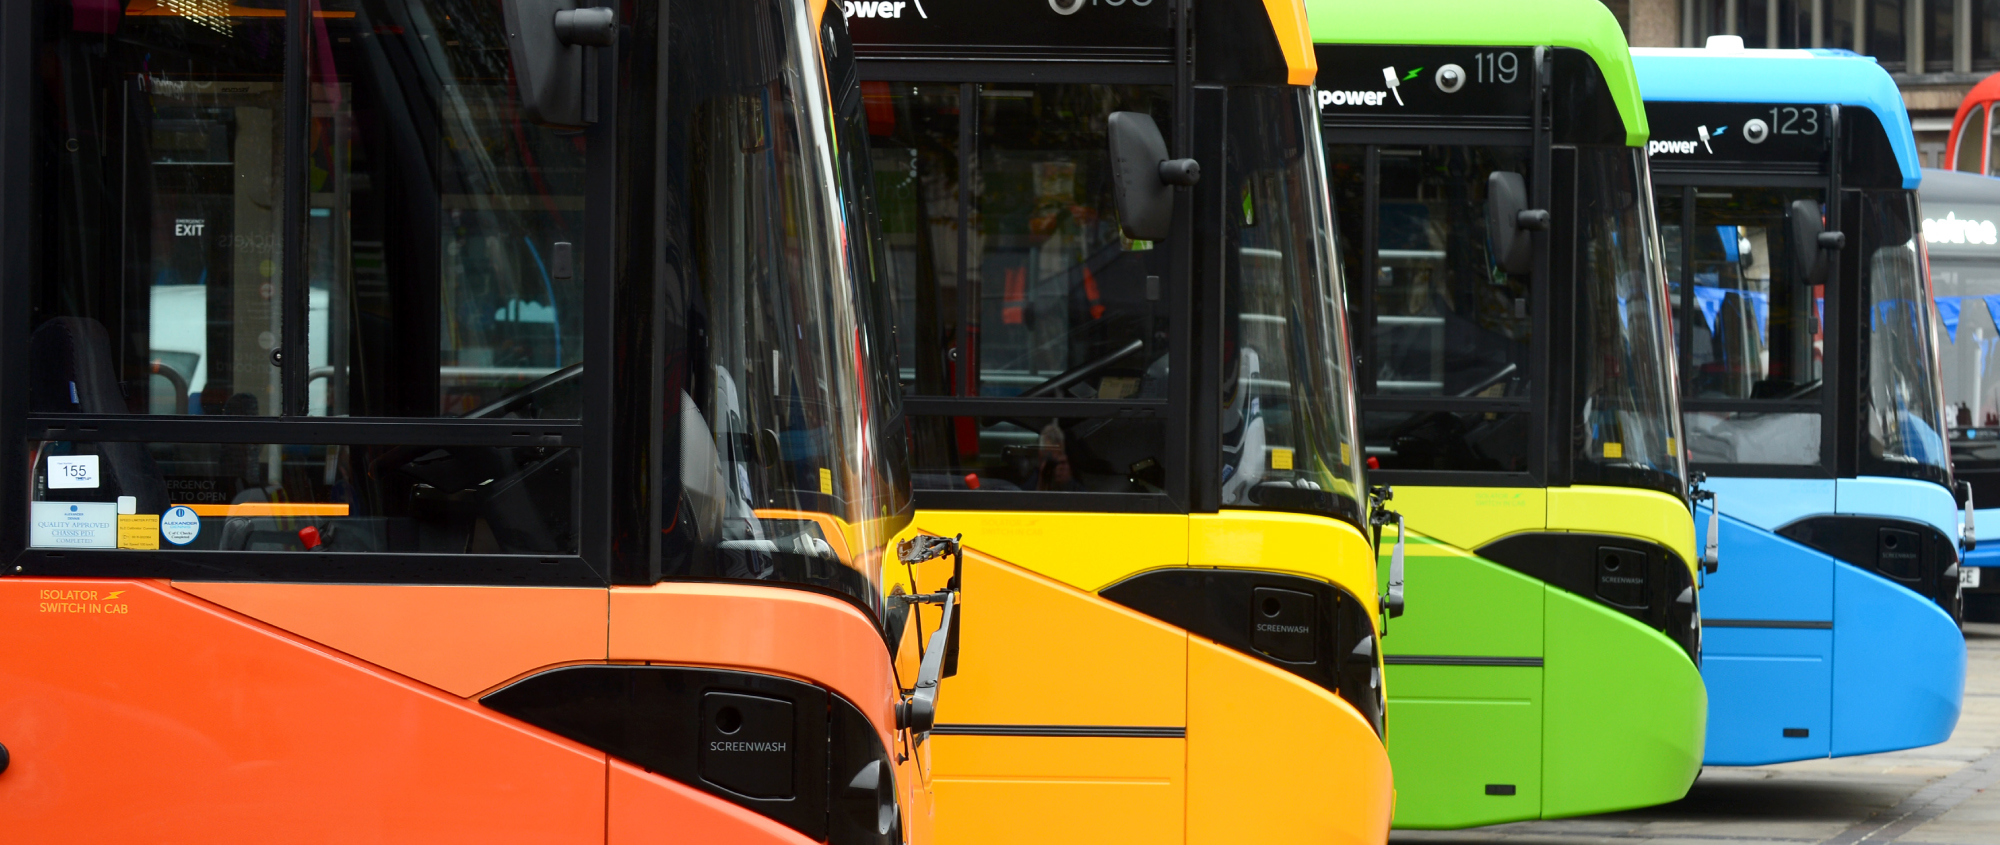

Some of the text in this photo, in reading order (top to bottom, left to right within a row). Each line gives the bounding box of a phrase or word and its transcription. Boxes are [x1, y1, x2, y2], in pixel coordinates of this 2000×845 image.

[844, 1, 906, 18] ower
[1475, 52, 1519, 83] 119
[1318, 90, 1387, 109] power
[1769, 107, 1819, 135] 123
[1649, 140, 1698, 156] power
[175, 224, 205, 236] EXIT
[63, 465, 87, 477] 155
[166, 480, 216, 490] ERGENCY
[179, 491, 194, 501] TO
[197, 492, 227, 502] OPEN
[1601, 576, 1644, 584] SCREENWASH
[40, 589, 98, 600] ISOLATOR
[40, 602, 128, 614] SWITCH IN CAB
[1256, 623, 1309, 633] SCREENWASH
[710, 741, 786, 751] SCREENWASH
